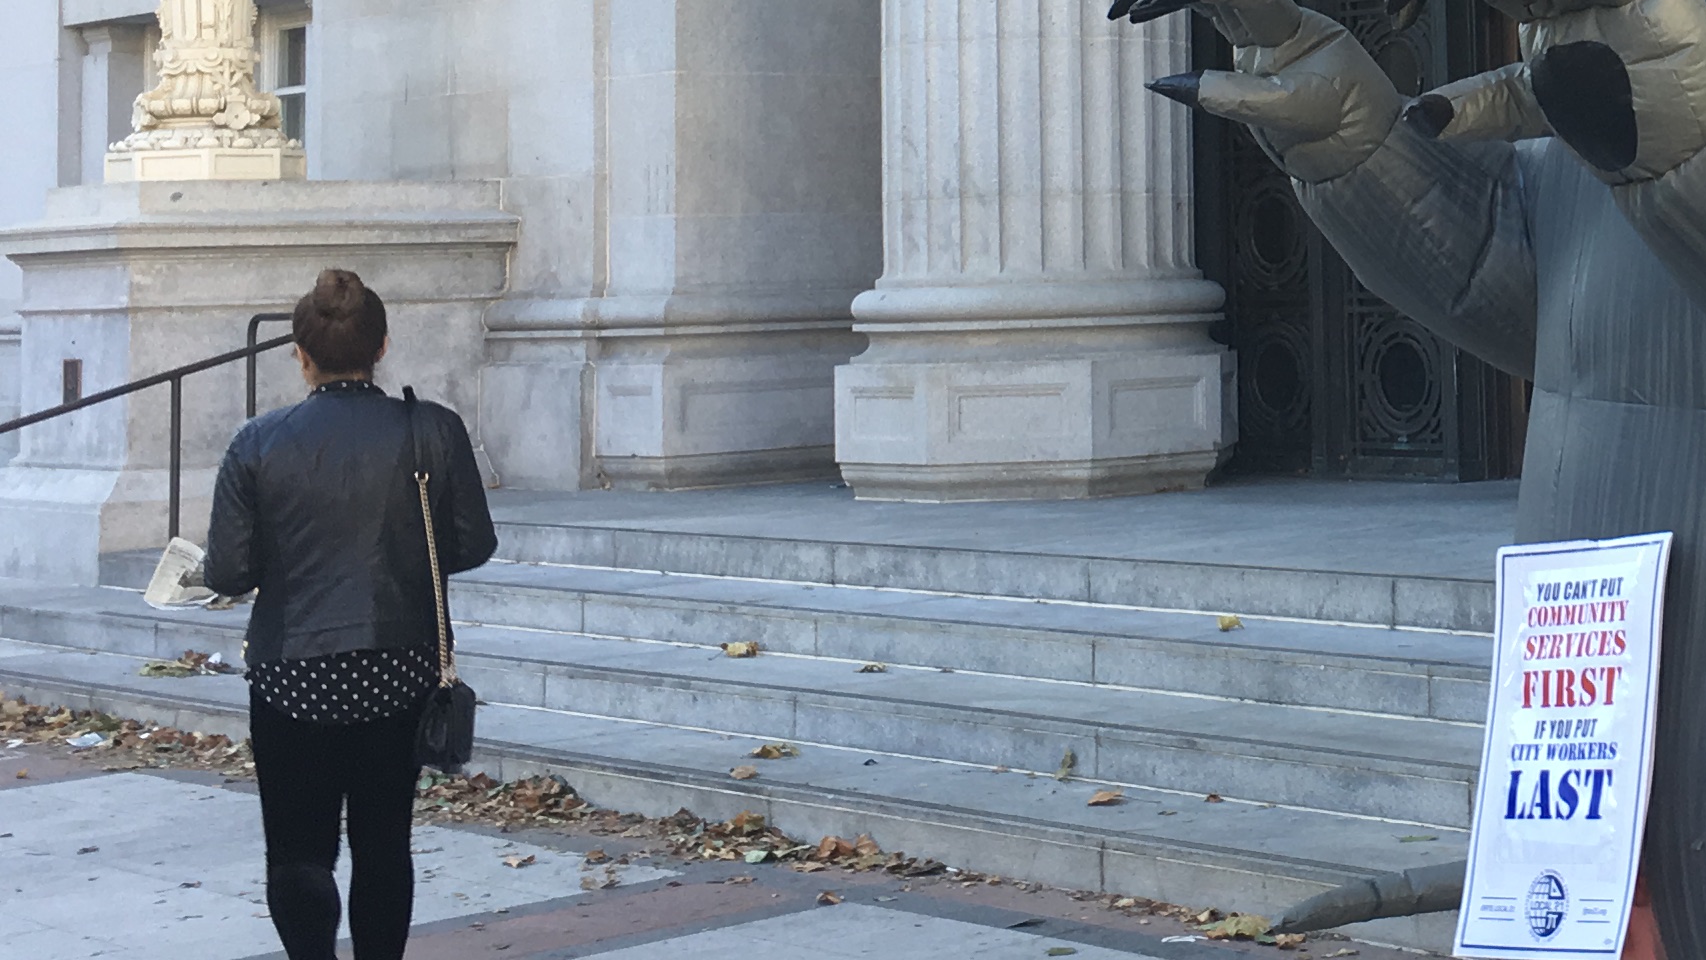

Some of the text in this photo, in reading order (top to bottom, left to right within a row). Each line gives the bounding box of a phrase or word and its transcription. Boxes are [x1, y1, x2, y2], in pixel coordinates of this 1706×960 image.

[1537, 582, 1561, 602] YOU
[1599, 576, 1624, 598] PUT
[1528, 600, 1629, 628] COMMUNITY
[1523, 629, 1626, 661] SERVICES
[1521, 666, 1622, 709] FIRST
[1533, 718, 1598, 740] IF YOU PUT
[1511, 741, 1618, 762] CITY WORKERS
[1504, 769, 1613, 820] LAST
